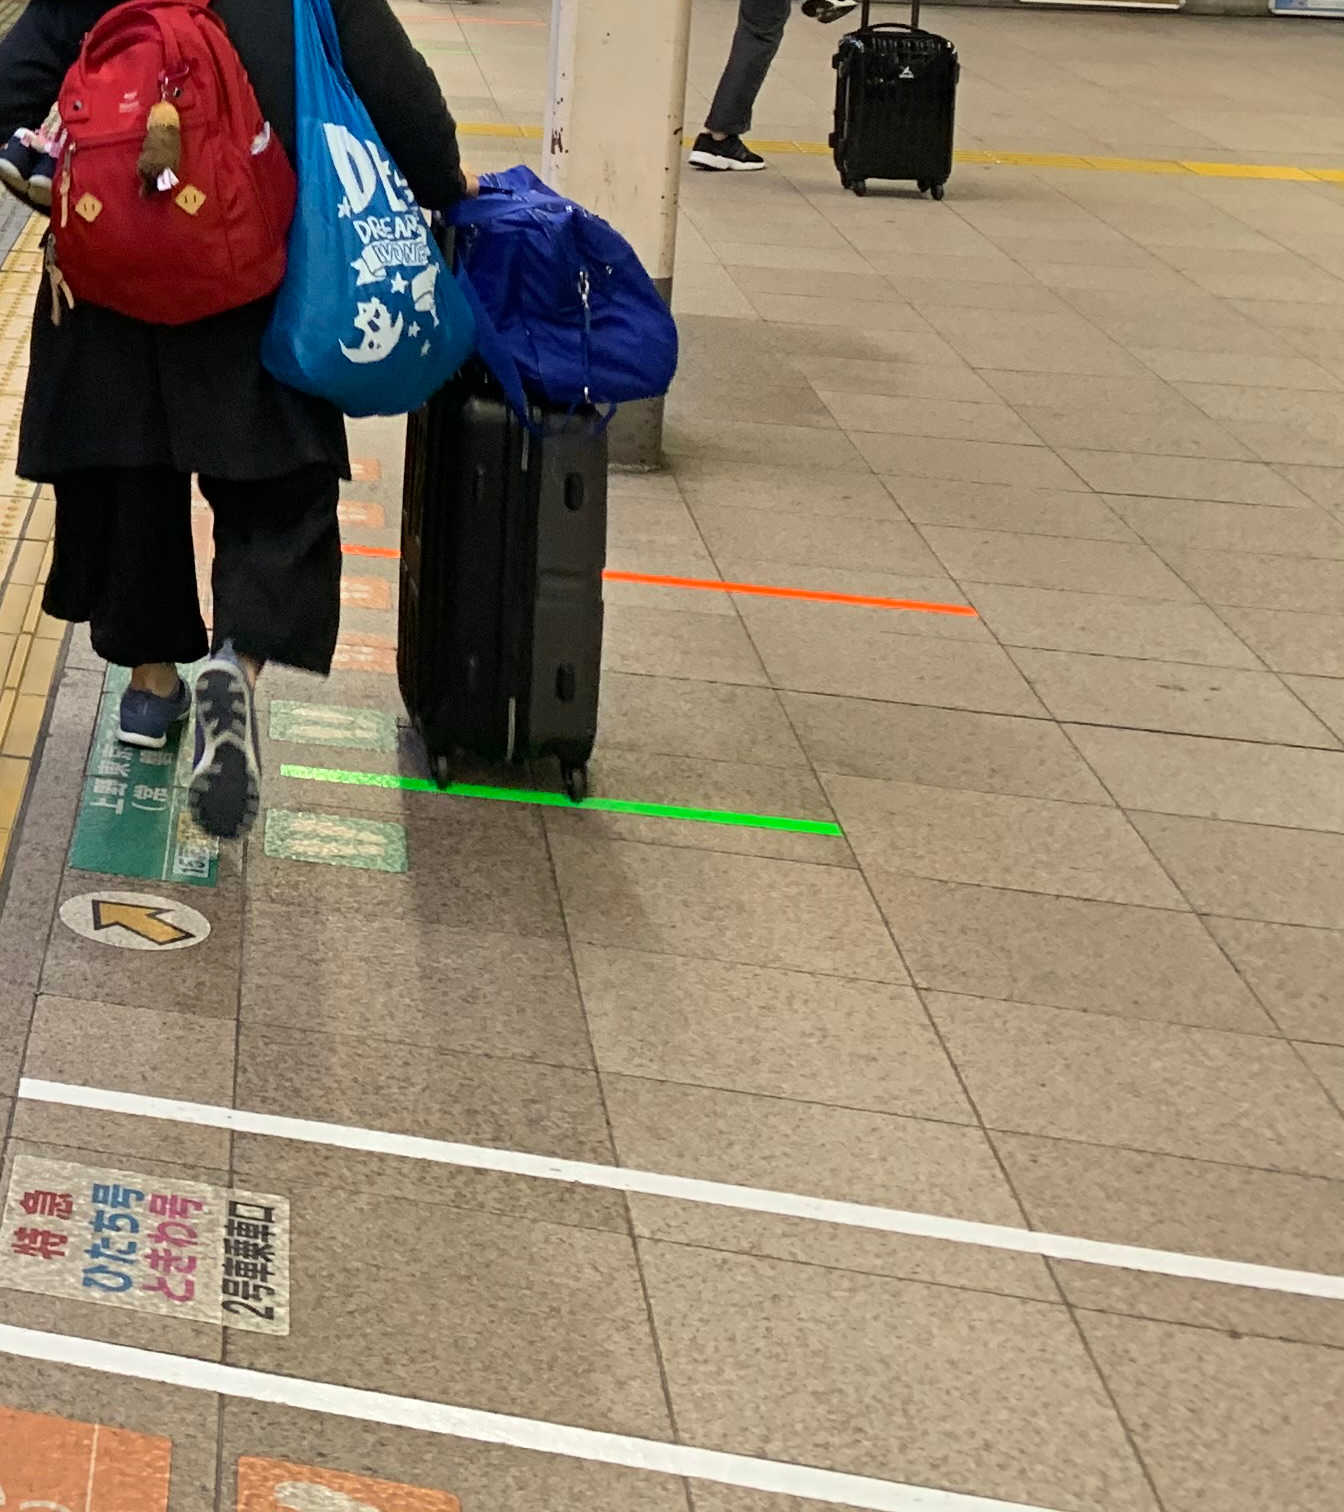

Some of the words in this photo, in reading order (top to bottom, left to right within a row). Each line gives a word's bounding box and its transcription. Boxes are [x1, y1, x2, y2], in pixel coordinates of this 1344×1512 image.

[12, 1188, 74, 1261] 特急
[81, 1182, 146, 1294] ひたち号
[142, 1192, 205, 1304] ときわ号
[221, 1199, 277, 1322] 2号車乗車口
